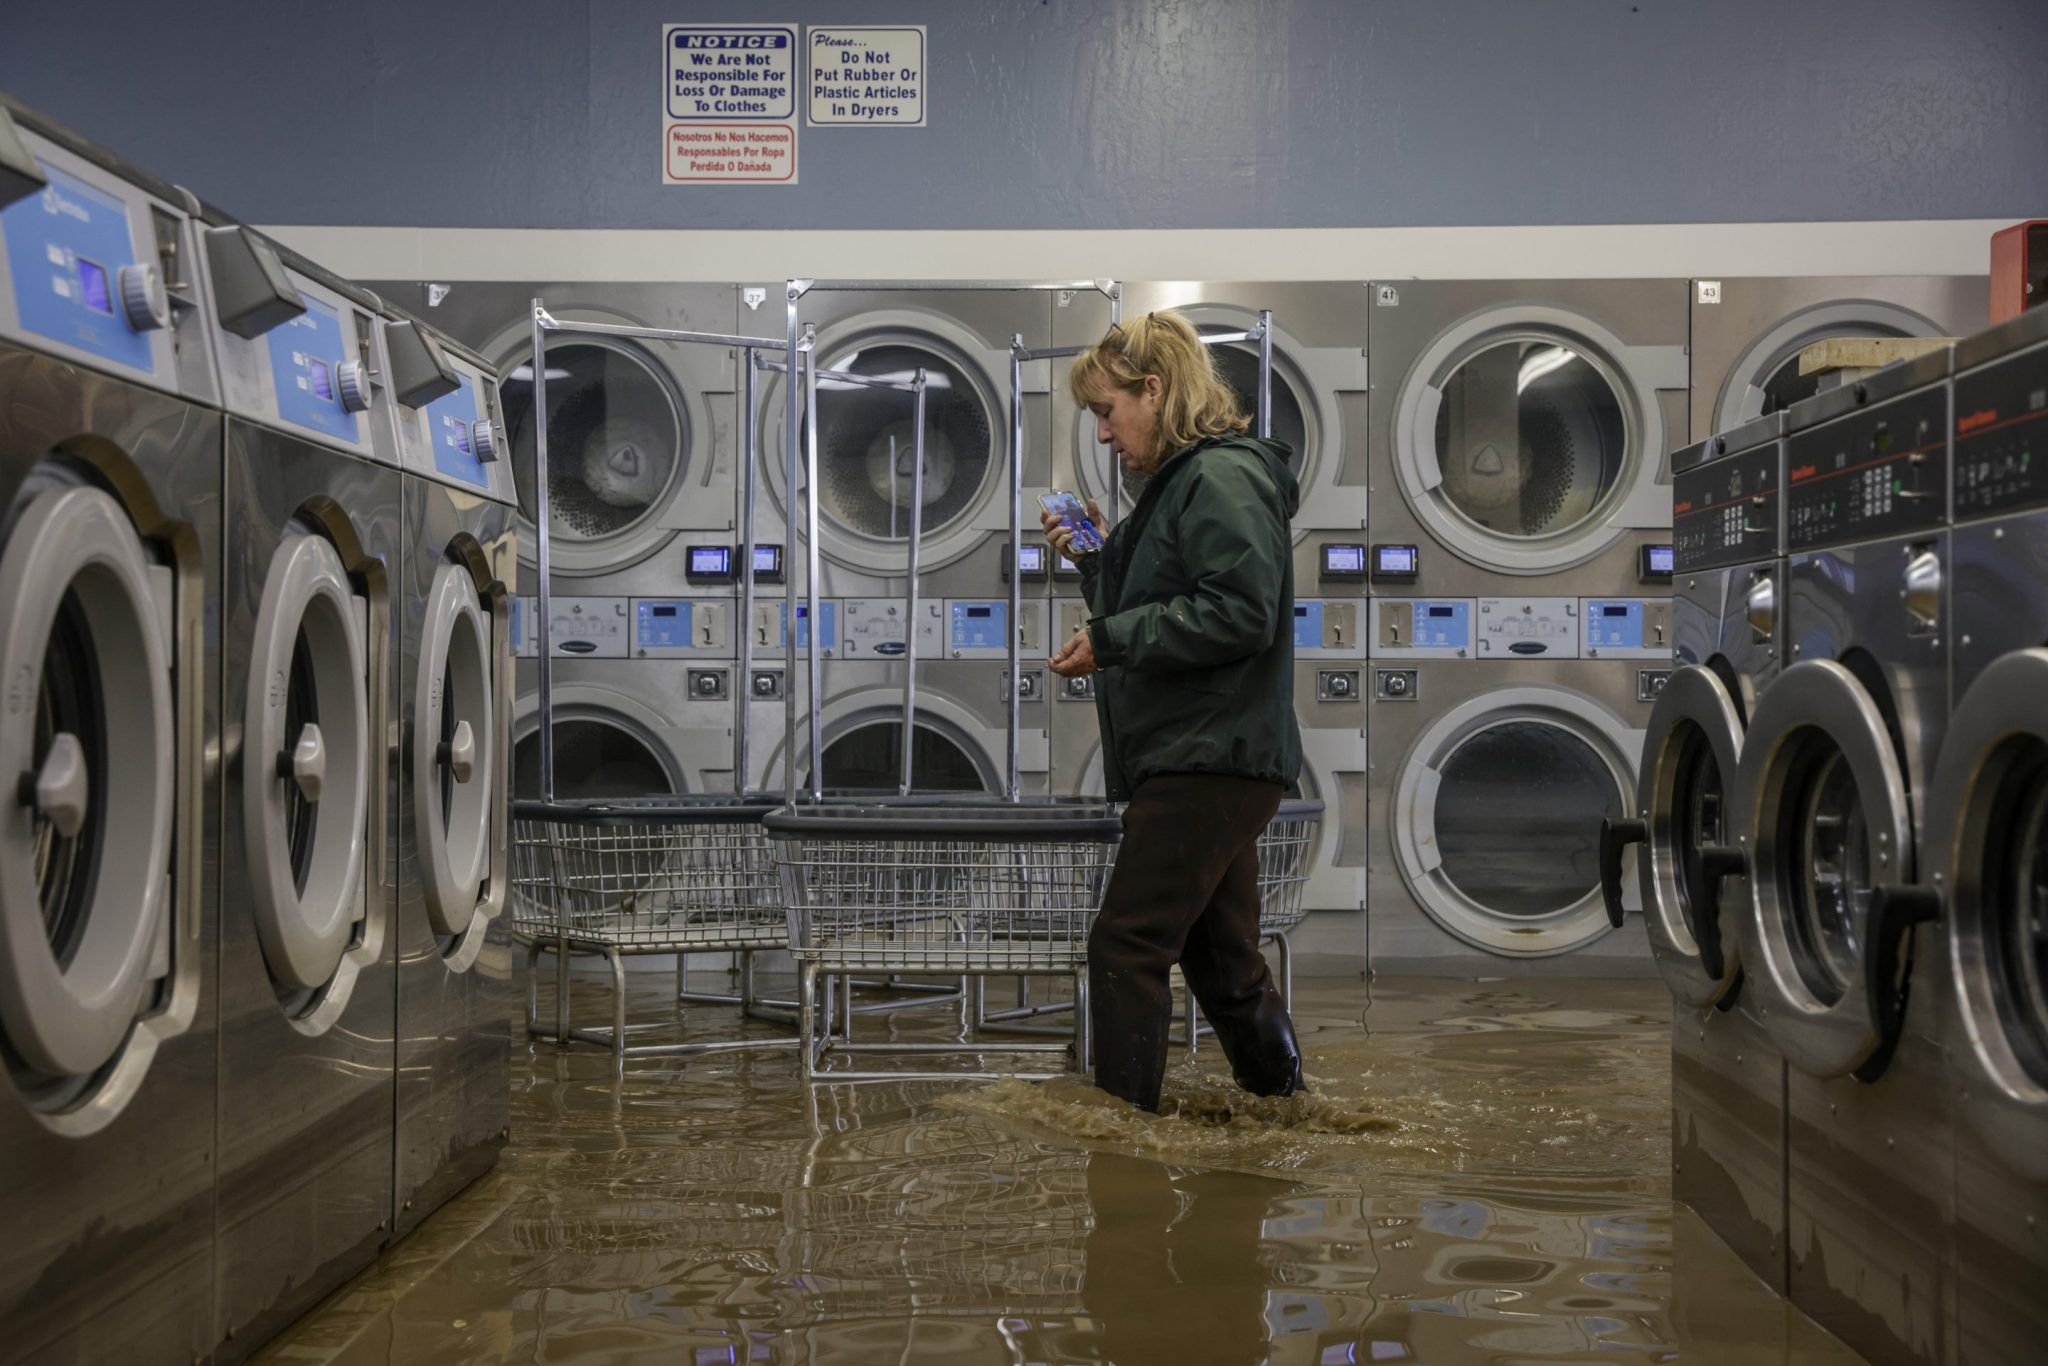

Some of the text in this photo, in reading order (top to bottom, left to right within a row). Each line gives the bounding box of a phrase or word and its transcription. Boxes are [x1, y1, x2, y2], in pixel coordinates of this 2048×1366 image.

[687, 36, 777, 48] NOTICE
[814, 34, 867, 47] Please...
[691, 54, 771, 66] We Are Not
[841, 51, 890, 64] Do Not
[675, 69, 786, 83] Responsible For
[814, 69, 917, 81] Put Rubber Or
[675, 85, 786, 100] Loss Or Damage
[814, 86, 917, 99] Plastic Articles
[695, 100, 767, 112] To Clothes
[832, 103, 899, 119] In Dryers
[673, 132, 789, 142] Nosotros No Nos Hacemos
[677, 146, 785, 159] Responsables Por Ropa
[690, 161, 772, 172] Perdida O Dañada
[1382, 290, 1394, 300] 41
[1703, 287, 1716, 297] 43
[748, 294, 760, 303] 37
